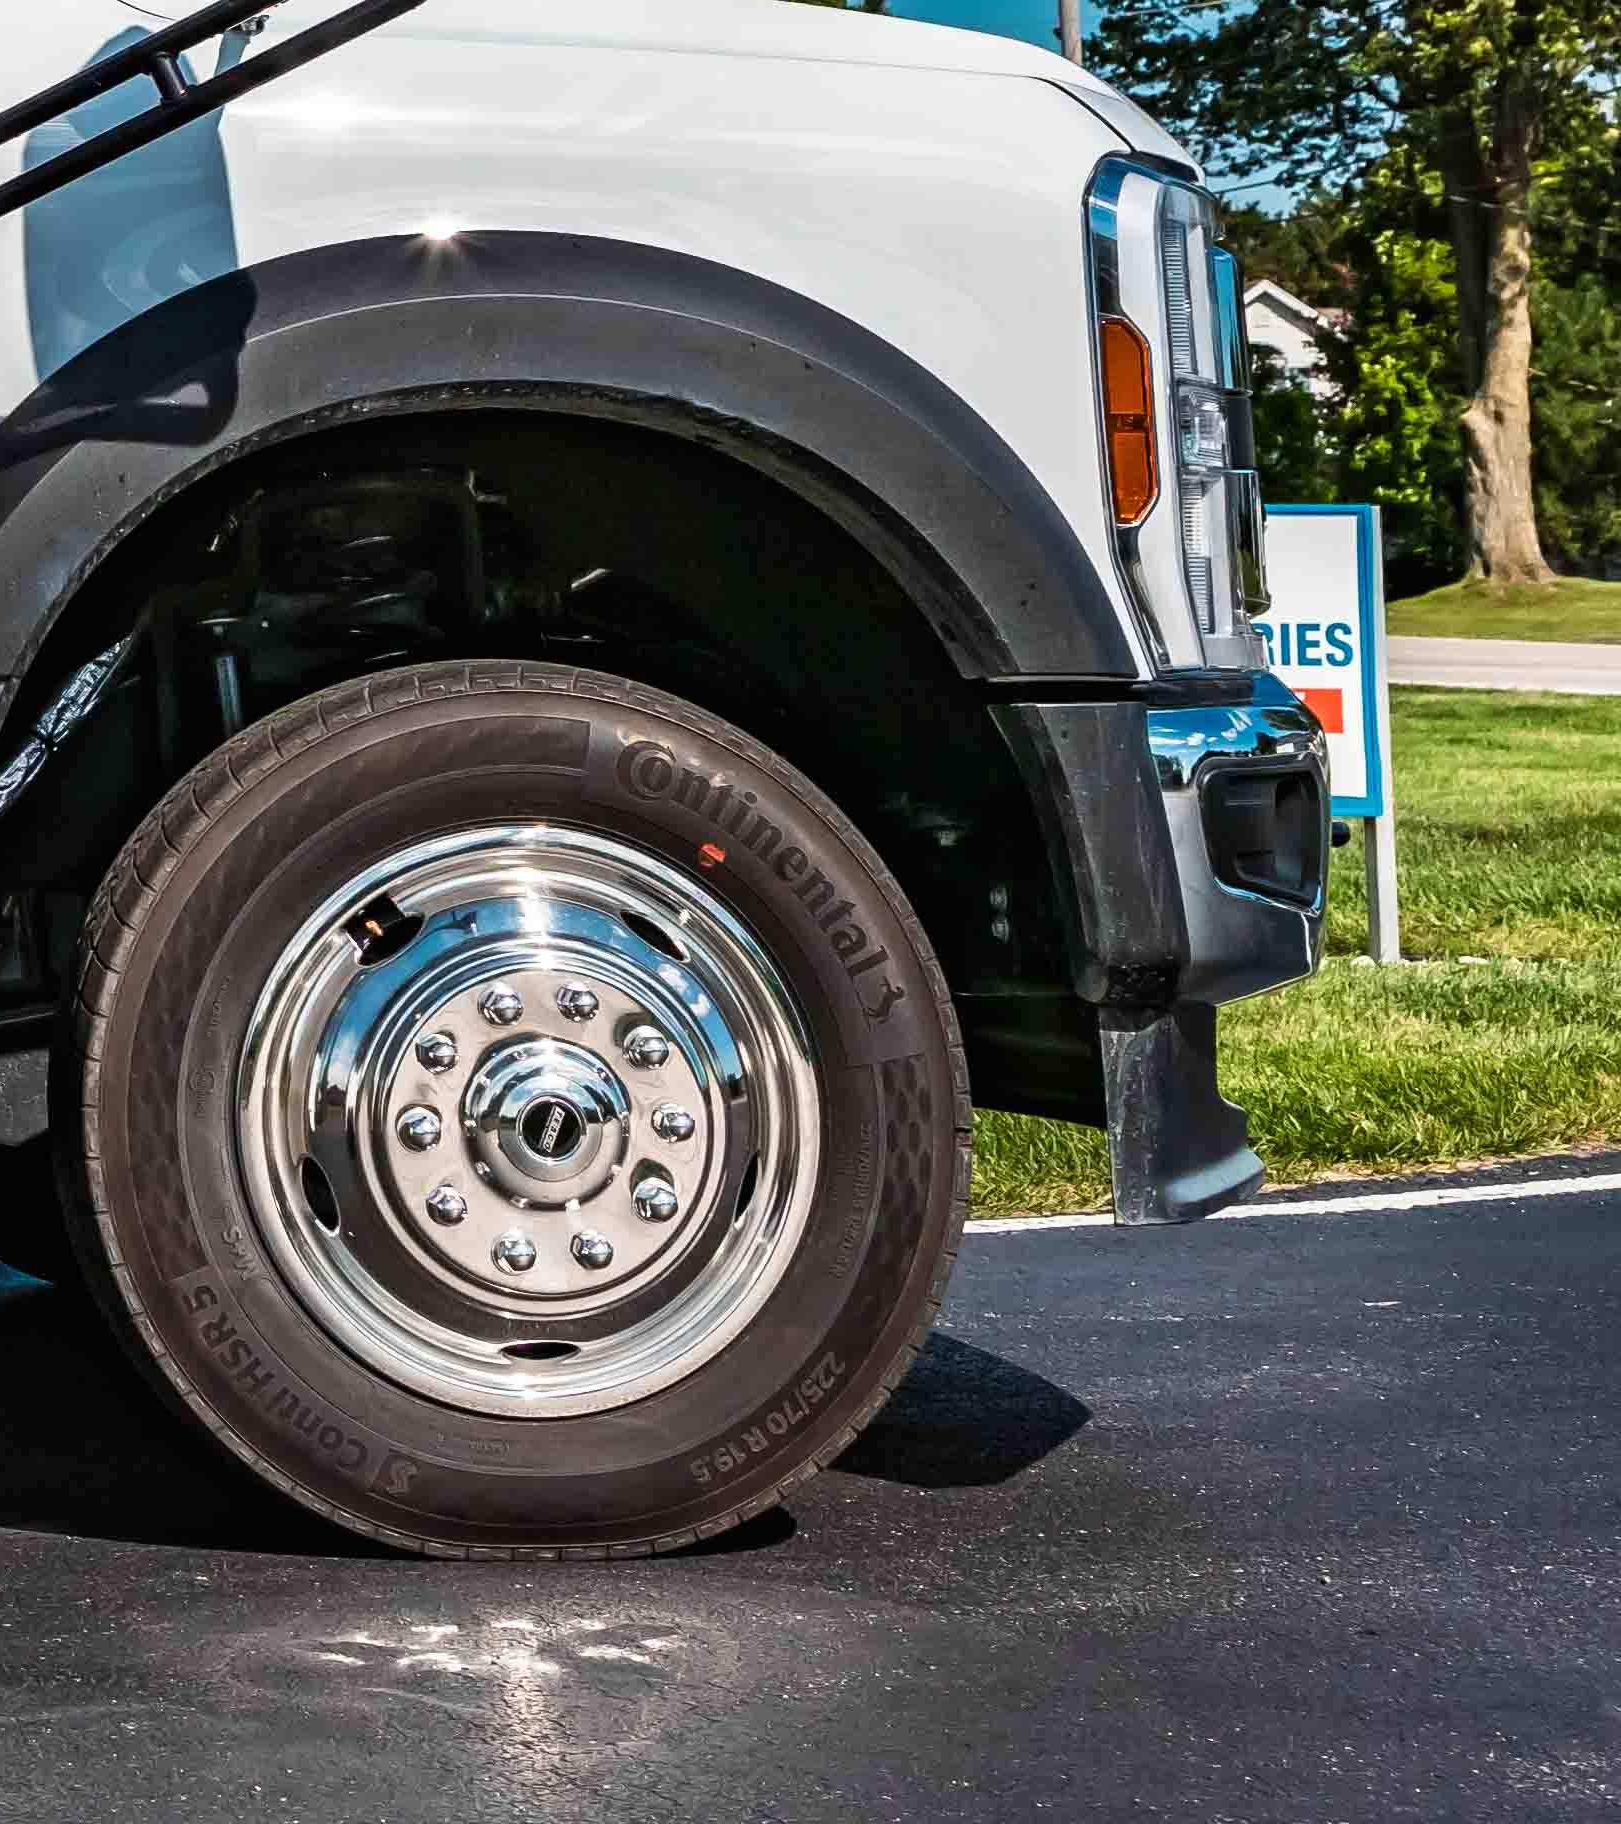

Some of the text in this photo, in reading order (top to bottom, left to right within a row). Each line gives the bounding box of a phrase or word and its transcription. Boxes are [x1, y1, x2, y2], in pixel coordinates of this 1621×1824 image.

[615, 739, 890, 977] Continental
[765, 1351, 847, 1436] 225/70
[740, 1427, 770, 1453] R
